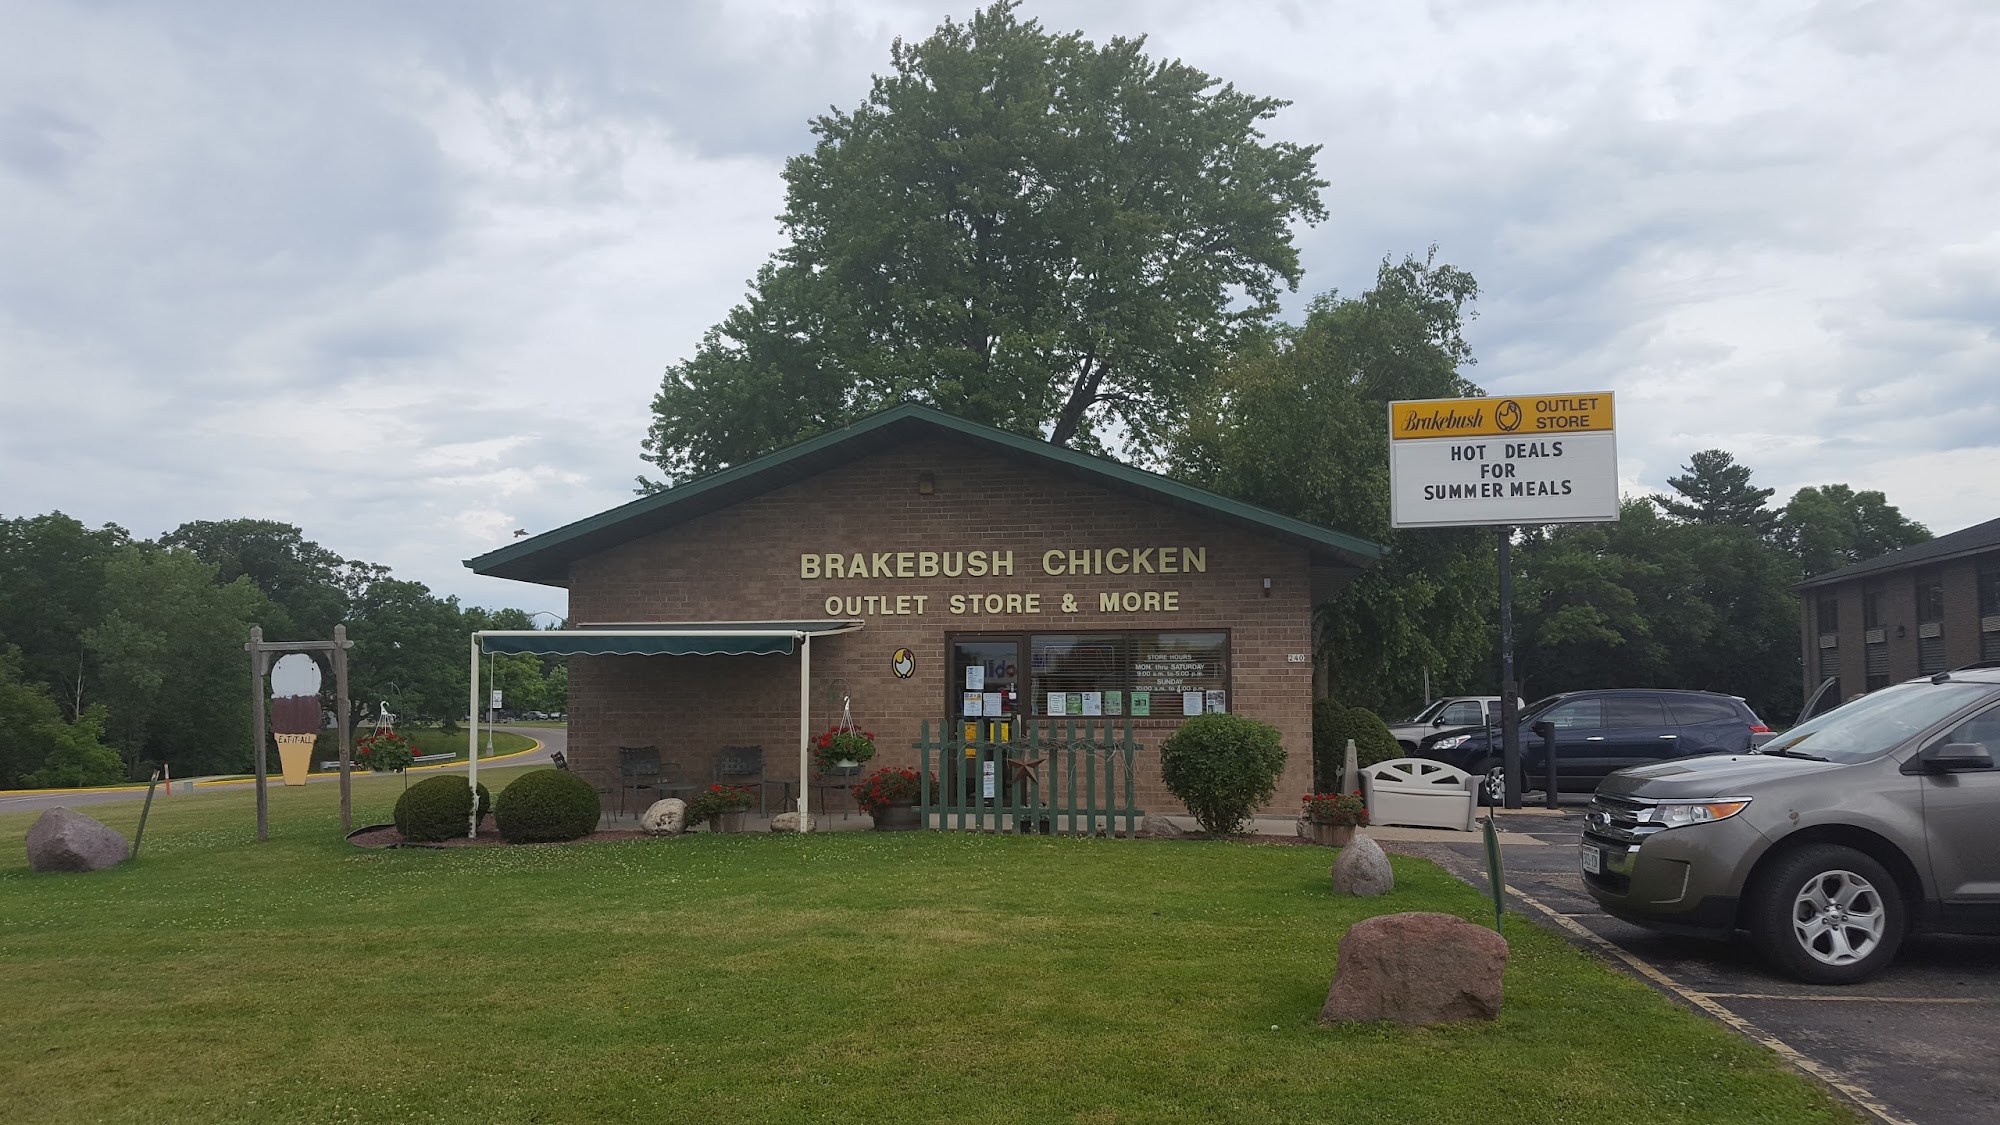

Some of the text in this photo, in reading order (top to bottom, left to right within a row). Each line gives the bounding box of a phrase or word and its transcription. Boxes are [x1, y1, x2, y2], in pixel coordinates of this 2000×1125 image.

[1536, 398, 1599, 412] OUTLET
[1403, 409, 1483, 431] Brakebush
[1536, 415, 1590, 429] STORE
[1451, 442, 1563, 461] HOT DEALS
[1480, 463, 1516, 478] FOR
[1424, 480, 1572, 500] SUMMER MEALS
[801, 547, 1206, 578] BRAKEBUSH CHICKEN
[825, 592, 1179, 615] OUTLET STORE & MORE
[1288, 654, 1305, 662] 240
